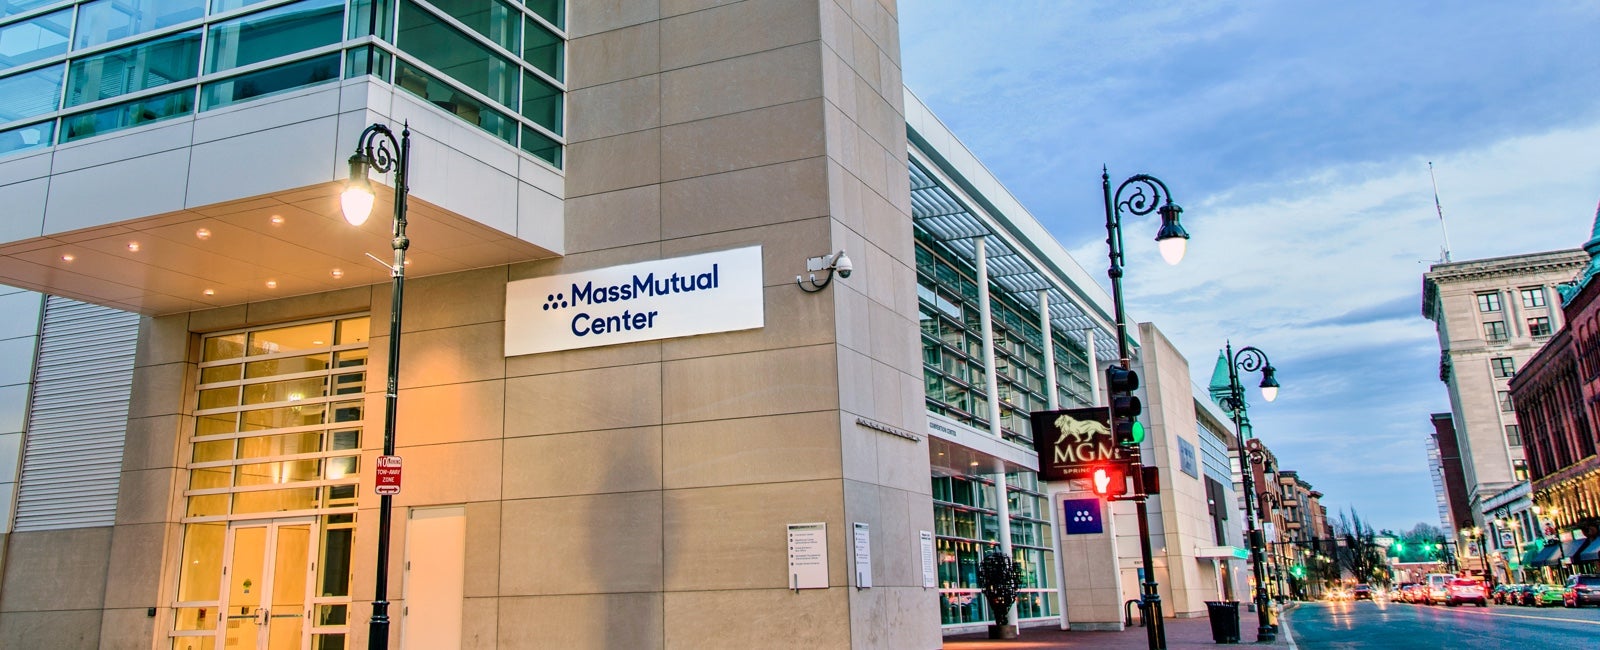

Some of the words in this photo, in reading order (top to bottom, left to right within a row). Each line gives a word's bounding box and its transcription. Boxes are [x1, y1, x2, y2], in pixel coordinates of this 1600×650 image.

[572, 264, 718, 306] MassMutual
[571, 309, 658, 337] Center
[378, 458, 387, 467] NO
[1053, 442, 1120, 464] MGM
